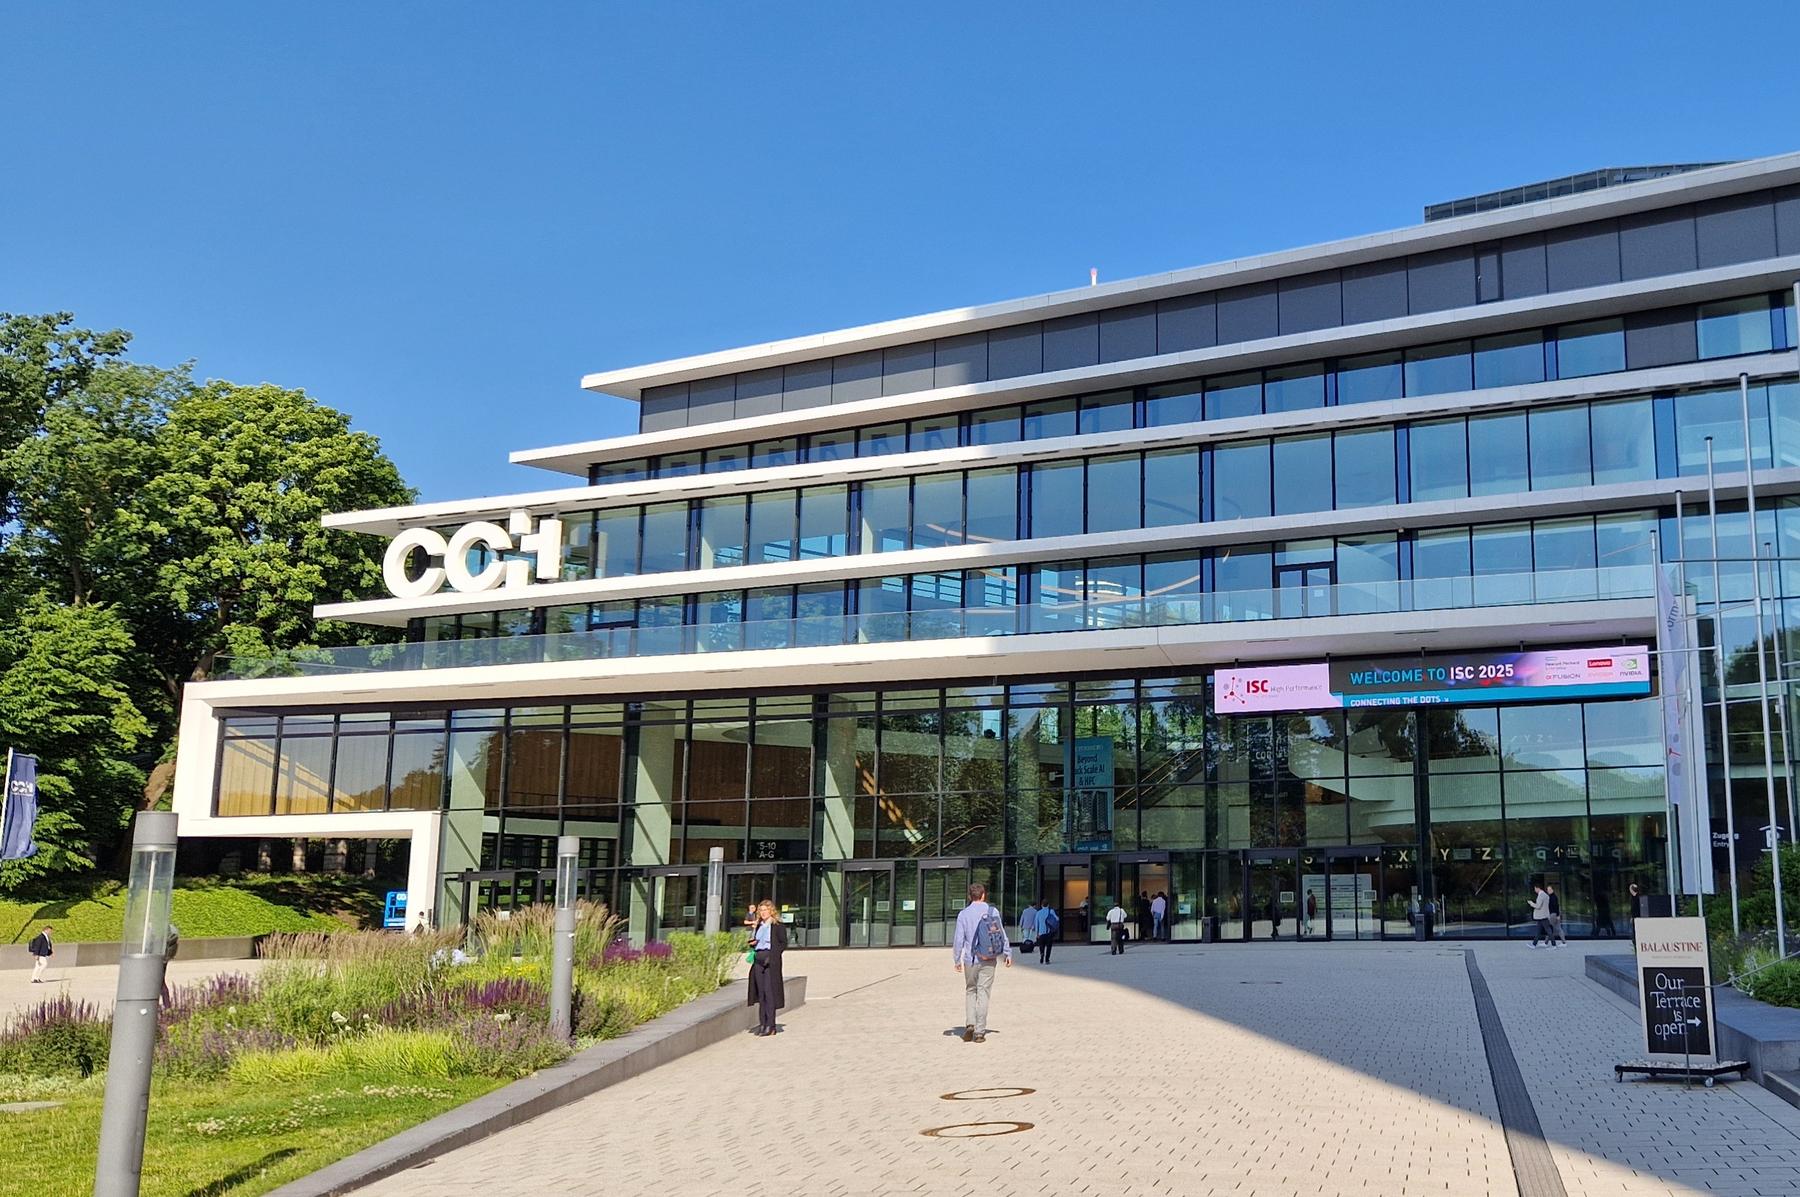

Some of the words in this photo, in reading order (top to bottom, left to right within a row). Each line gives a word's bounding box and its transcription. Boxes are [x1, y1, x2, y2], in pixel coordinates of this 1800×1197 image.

[383, 509, 562, 599] CCH
[1351, 669, 1423, 685] WELCOME
[1427, 668, 1446, 681] TO
[1450, 666, 1475, 680] ISC
[1479, 664, 1514, 678] 2025
[1246, 680, 1268, 693] ISC
[1350, 698, 1401, 707] CONNECTING
[1403, 697, 1418, 705] THE
[1420, 696, 1441, 704] DOTS
[759, 841, 777, 850] 5-10
[759, 851, 775, 859] A-G
[1398, 850, 1409, 862] X
[1440, 849, 1450, 861] Y
[1482, 848, 1491, 860] Z
[1640, 942, 1703, 953] BALAUSTINE
[1655, 973, 1685, 990] Our
[1650, 991, 1701, 1008] Terrace
[1654, 1022, 1688, 1041] open
